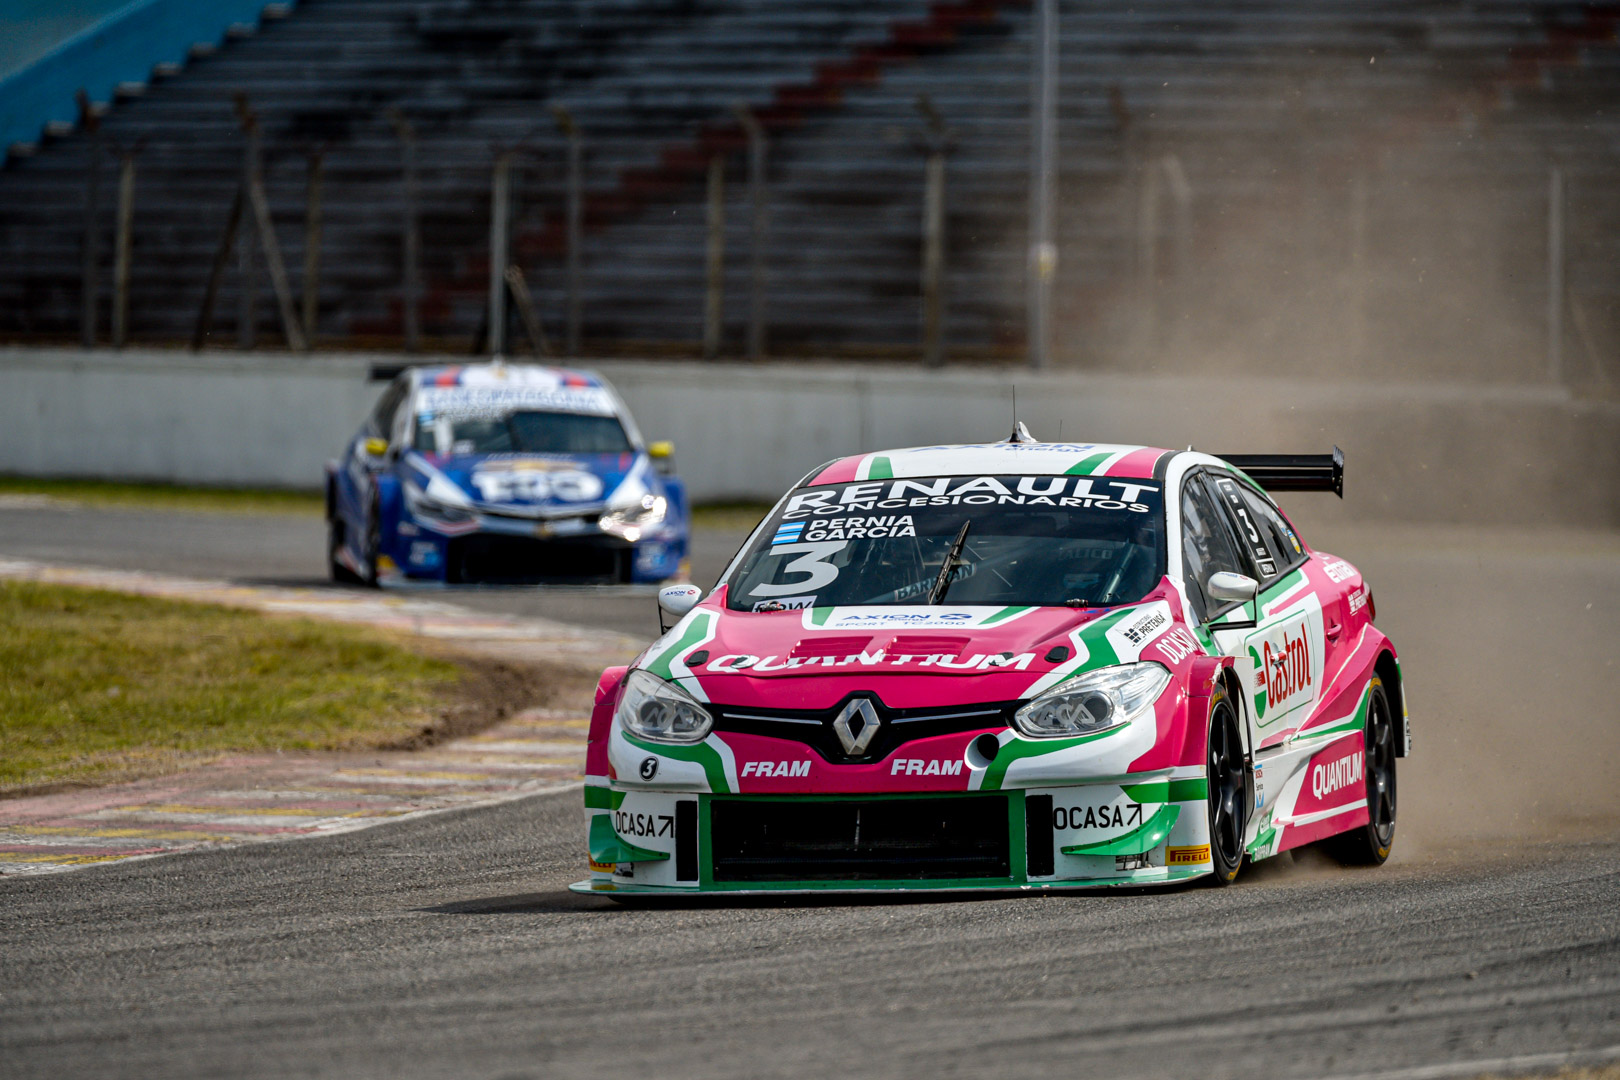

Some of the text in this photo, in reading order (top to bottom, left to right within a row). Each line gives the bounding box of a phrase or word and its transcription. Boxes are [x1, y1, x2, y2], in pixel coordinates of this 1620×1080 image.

[782, 494, 1149, 520] CONCESIONARIOS
[787, 477, 1158, 514] RENAULT
[809, 515, 914, 531] PERNIA
[748, 540, 849, 596] 3
[706, 649, 1036, 673] QUANTUM
[1263, 622, 1312, 709] Castrol
[641, 759, 657, 778] 3
[741, 760, 811, 777] FRAM
[890, 758, 964, 776] FRAM
[1312, 751, 1363, 800] QUANTUM
[615, 810, 656, 838] OCASA
[1053, 805, 1123, 831] OCASA
[1169, 847, 1210, 863] PIRELLI
